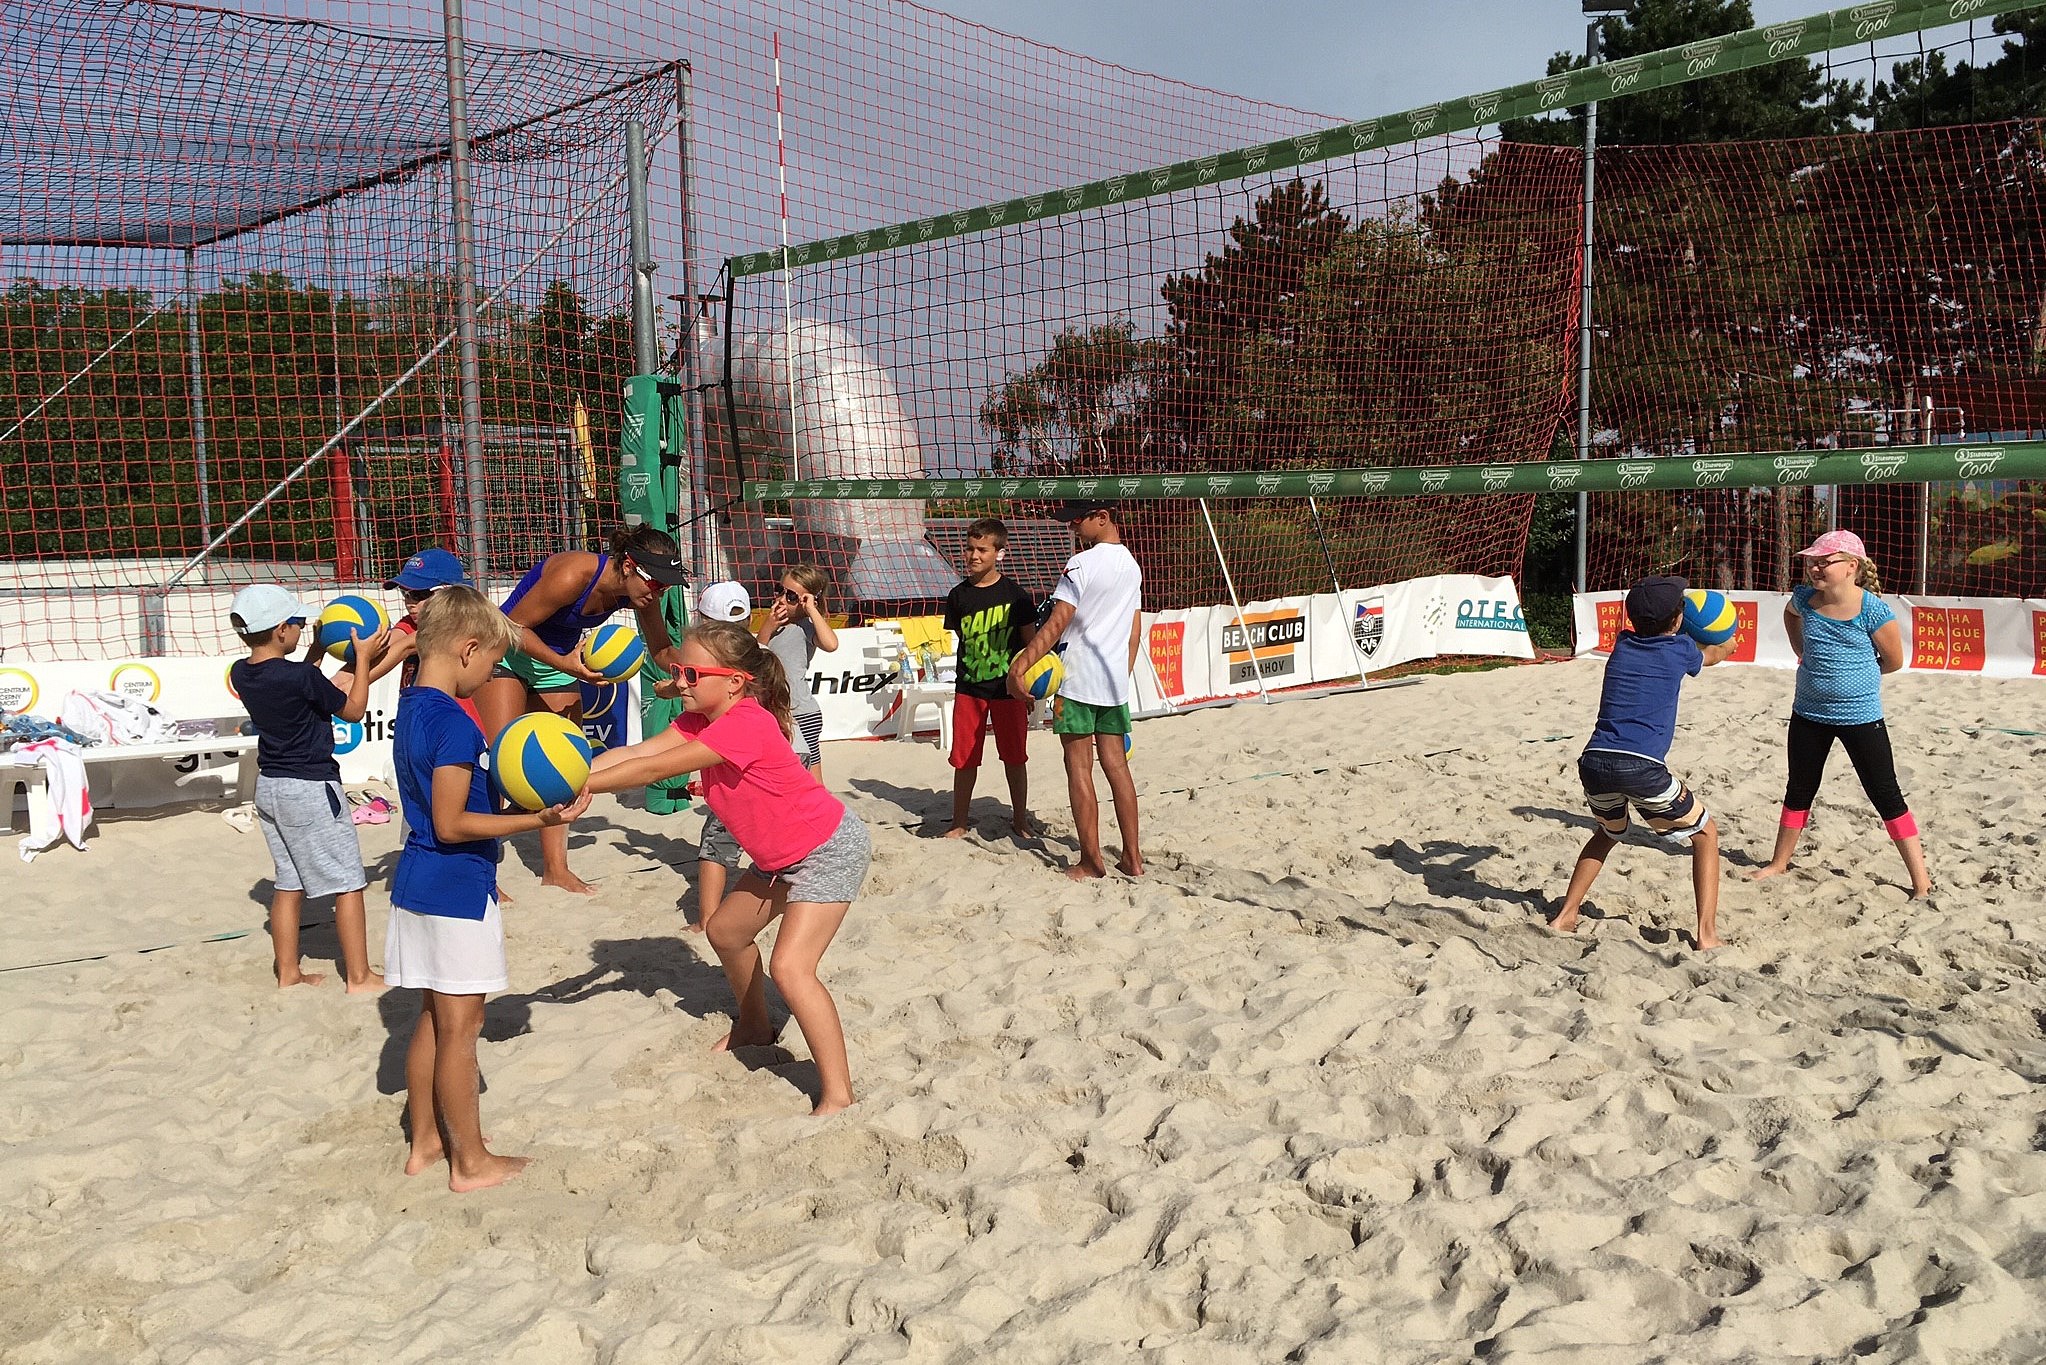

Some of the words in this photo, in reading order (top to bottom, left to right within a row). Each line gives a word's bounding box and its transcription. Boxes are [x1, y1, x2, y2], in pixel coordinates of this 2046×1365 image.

[1855, 11, 1891, 40] Cool
[1768, 33, 1801, 58] Cool
[1687, 51, 1720, 76] Cool
[1611, 66, 1642, 93] Cool
[1540, 83, 1569, 109] Cool
[1473, 102, 1500, 124] Cool
[1411, 115, 1437, 137] Cool
[1353, 131, 1377, 150] Cool
[1298, 143, 1320, 161] Cool
[1246, 154, 1267, 172] Cool
[1198, 166, 1217, 183] Cool
[1108, 185, 1125, 202] Cool
[1151, 176, 1170, 193] Cool
[1027, 203, 1043, 218] Cool
[1066, 194, 1083, 211] Cool
[990, 211, 1005, 226] Cool
[1777, 463, 1812, 484] Cool
[1864, 461, 1903, 482] Cool
[1958, 456, 2001, 479] Cool
[1422, 477, 1448, 494] Cool
[1484, 475, 1510, 492] Cool
[1550, 472, 1577, 491] Cool
[1620, 468, 1651, 489] Cool
[1696, 467, 1729, 487] Cool
[630, 483, 646, 501] Cool
[1163, 485, 1182, 497] Cool
[1210, 482, 1229, 496] Cool
[1258, 481, 1279, 496] Cool
[1310, 480, 1331, 495] Cool
[1364, 478, 1388, 495] Cool
[1268, 622, 1303, 641] CLUB
[1457, 619, 1525, 630] INTERNATIONAL
[804, 671, 898, 695] htex
